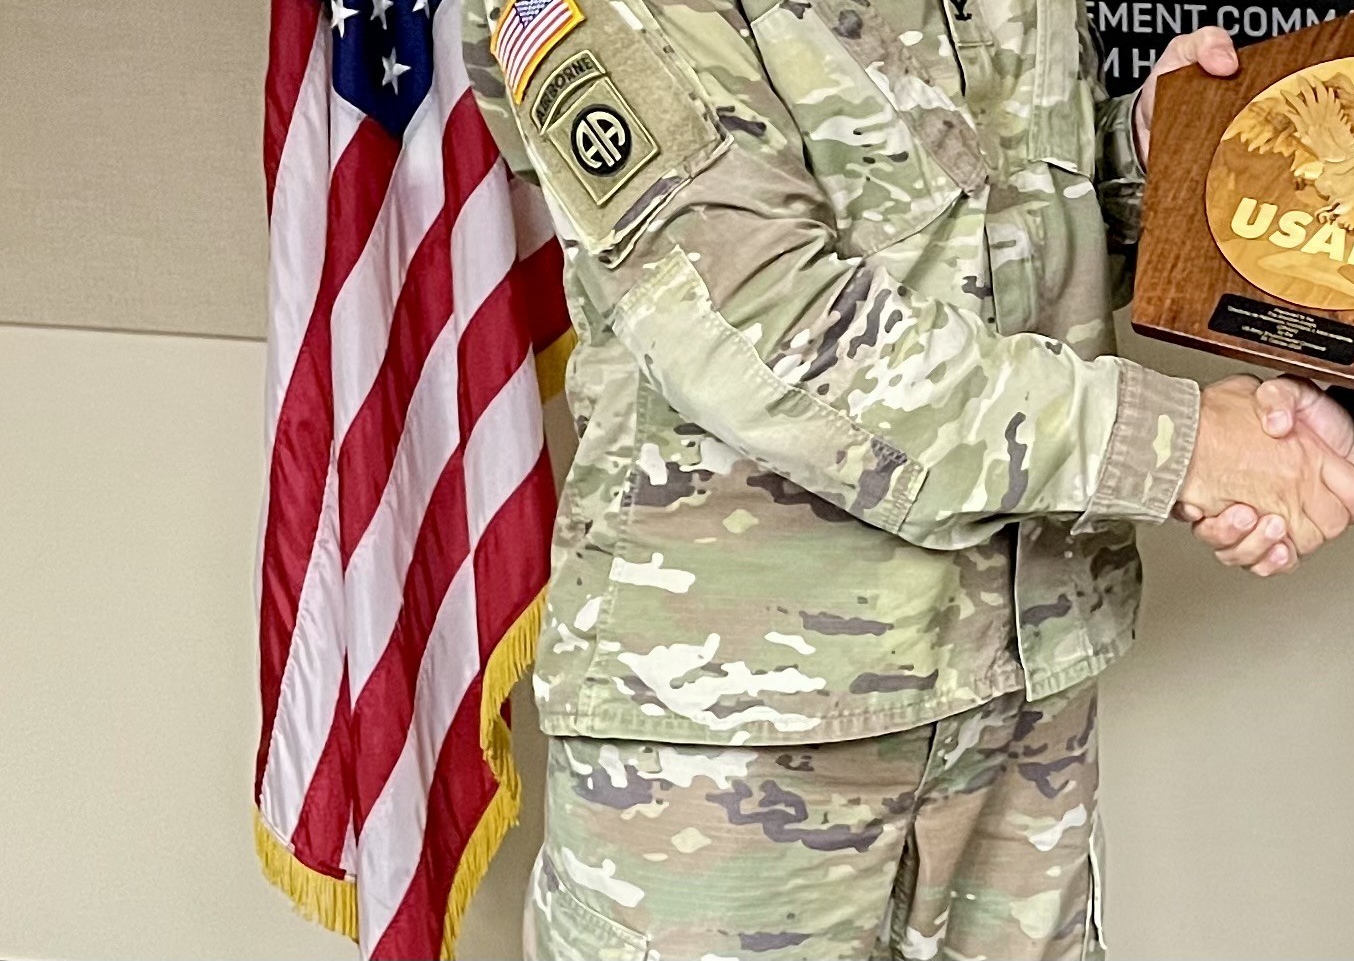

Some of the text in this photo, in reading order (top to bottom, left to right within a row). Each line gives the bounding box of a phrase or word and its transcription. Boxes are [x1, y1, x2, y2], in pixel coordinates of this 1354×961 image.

[1085, 1, 1207, 34] MENT
[1217, 5, 1354, 38] COMM
[535, 57, 593, 125] AIRBORNE
